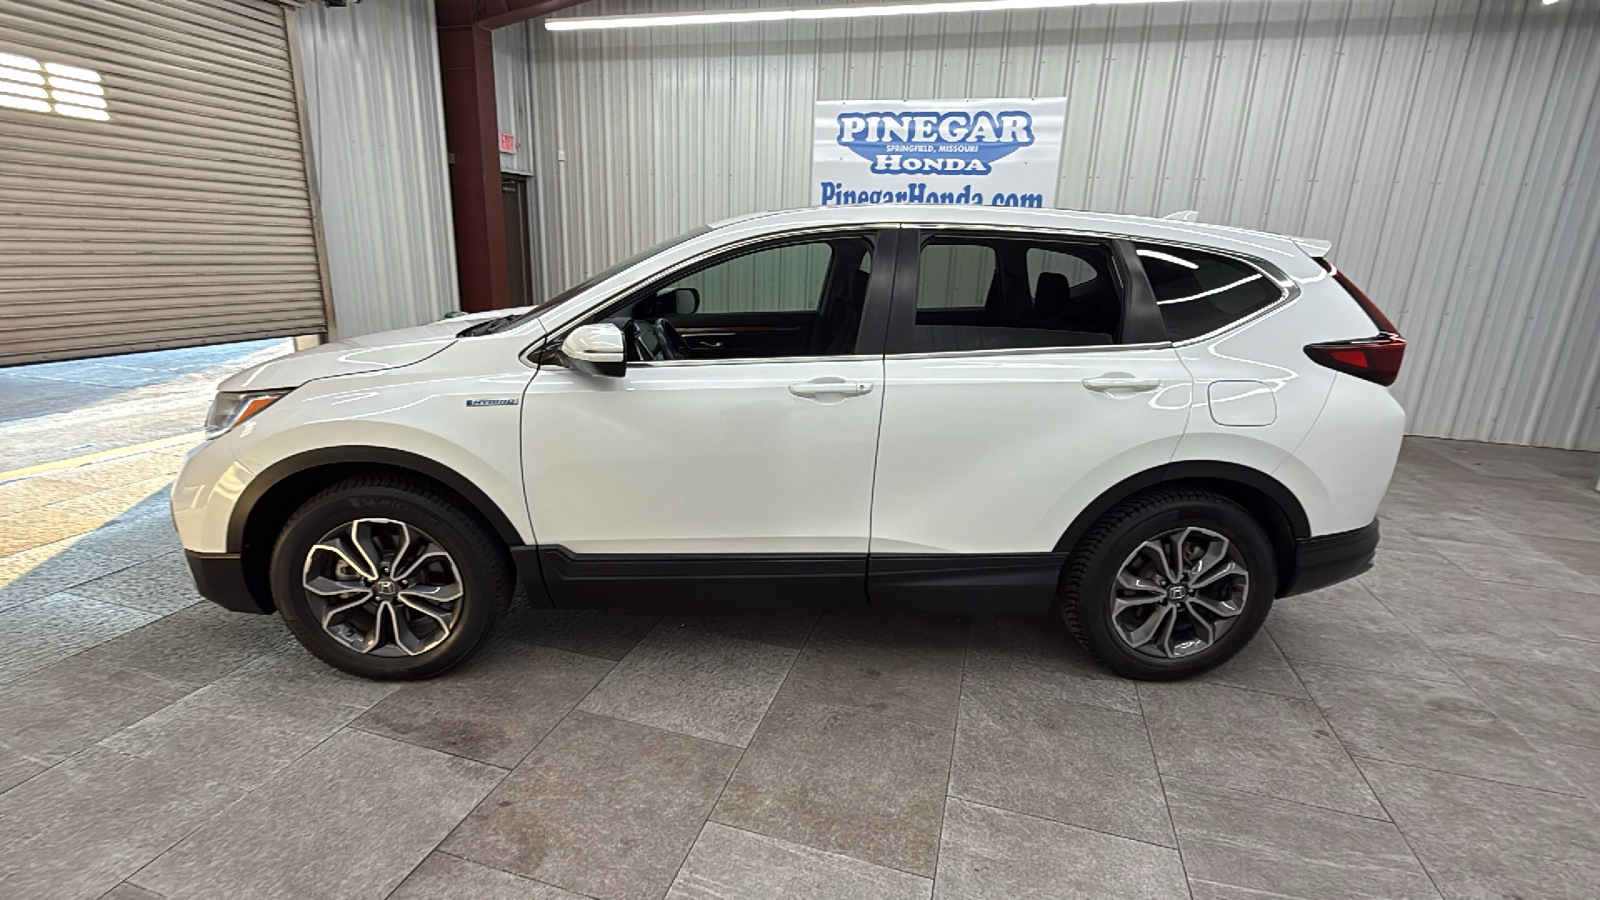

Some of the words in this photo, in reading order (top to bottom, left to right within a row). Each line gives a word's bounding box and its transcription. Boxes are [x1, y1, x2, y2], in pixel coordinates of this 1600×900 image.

[840, 116, 1031, 142] PINEGAR
[886, 144, 936, 153] SPRINGFIELD,
[938, 144, 979, 153] MISSOURI
[821, 182, 1042, 208] PinegarHondacom
